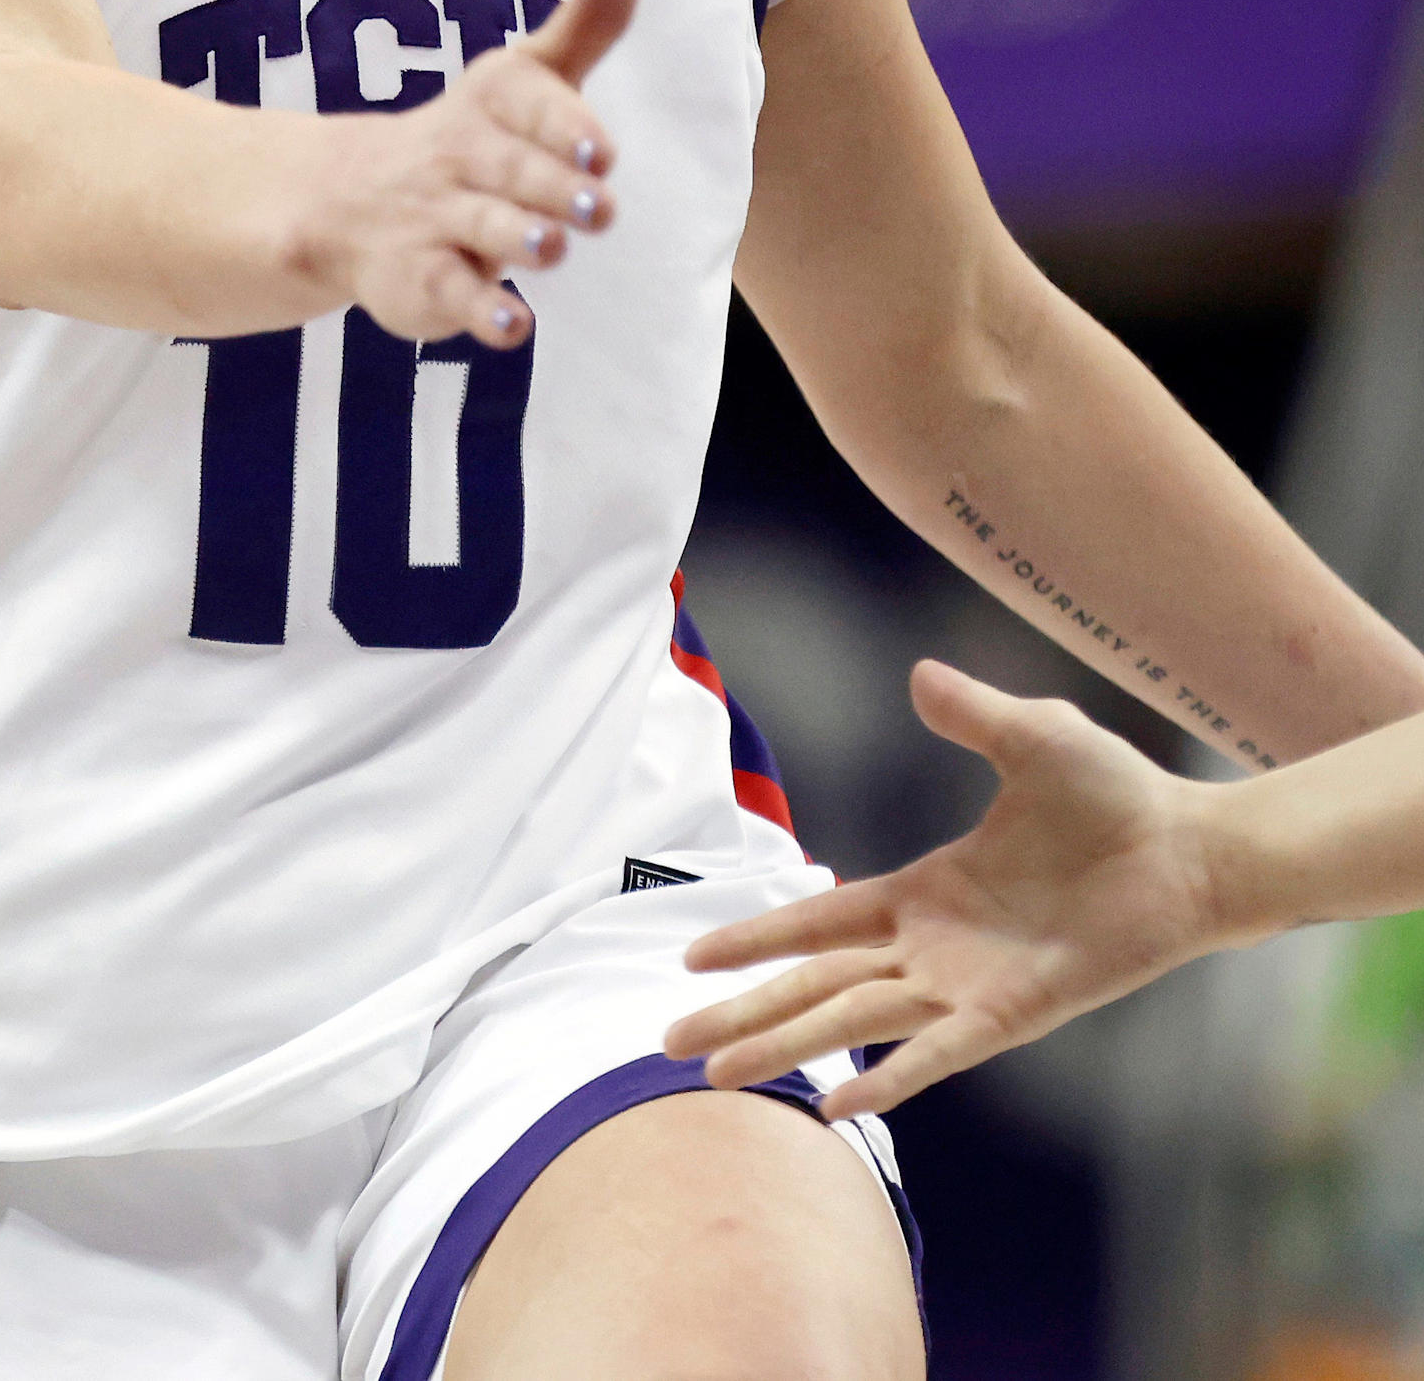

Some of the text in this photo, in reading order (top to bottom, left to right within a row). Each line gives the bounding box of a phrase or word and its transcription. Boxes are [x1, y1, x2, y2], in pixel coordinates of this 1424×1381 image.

[171, 278, 536, 649] 10
[942, 488, 1232, 733] THE JOURNEY IS THE
